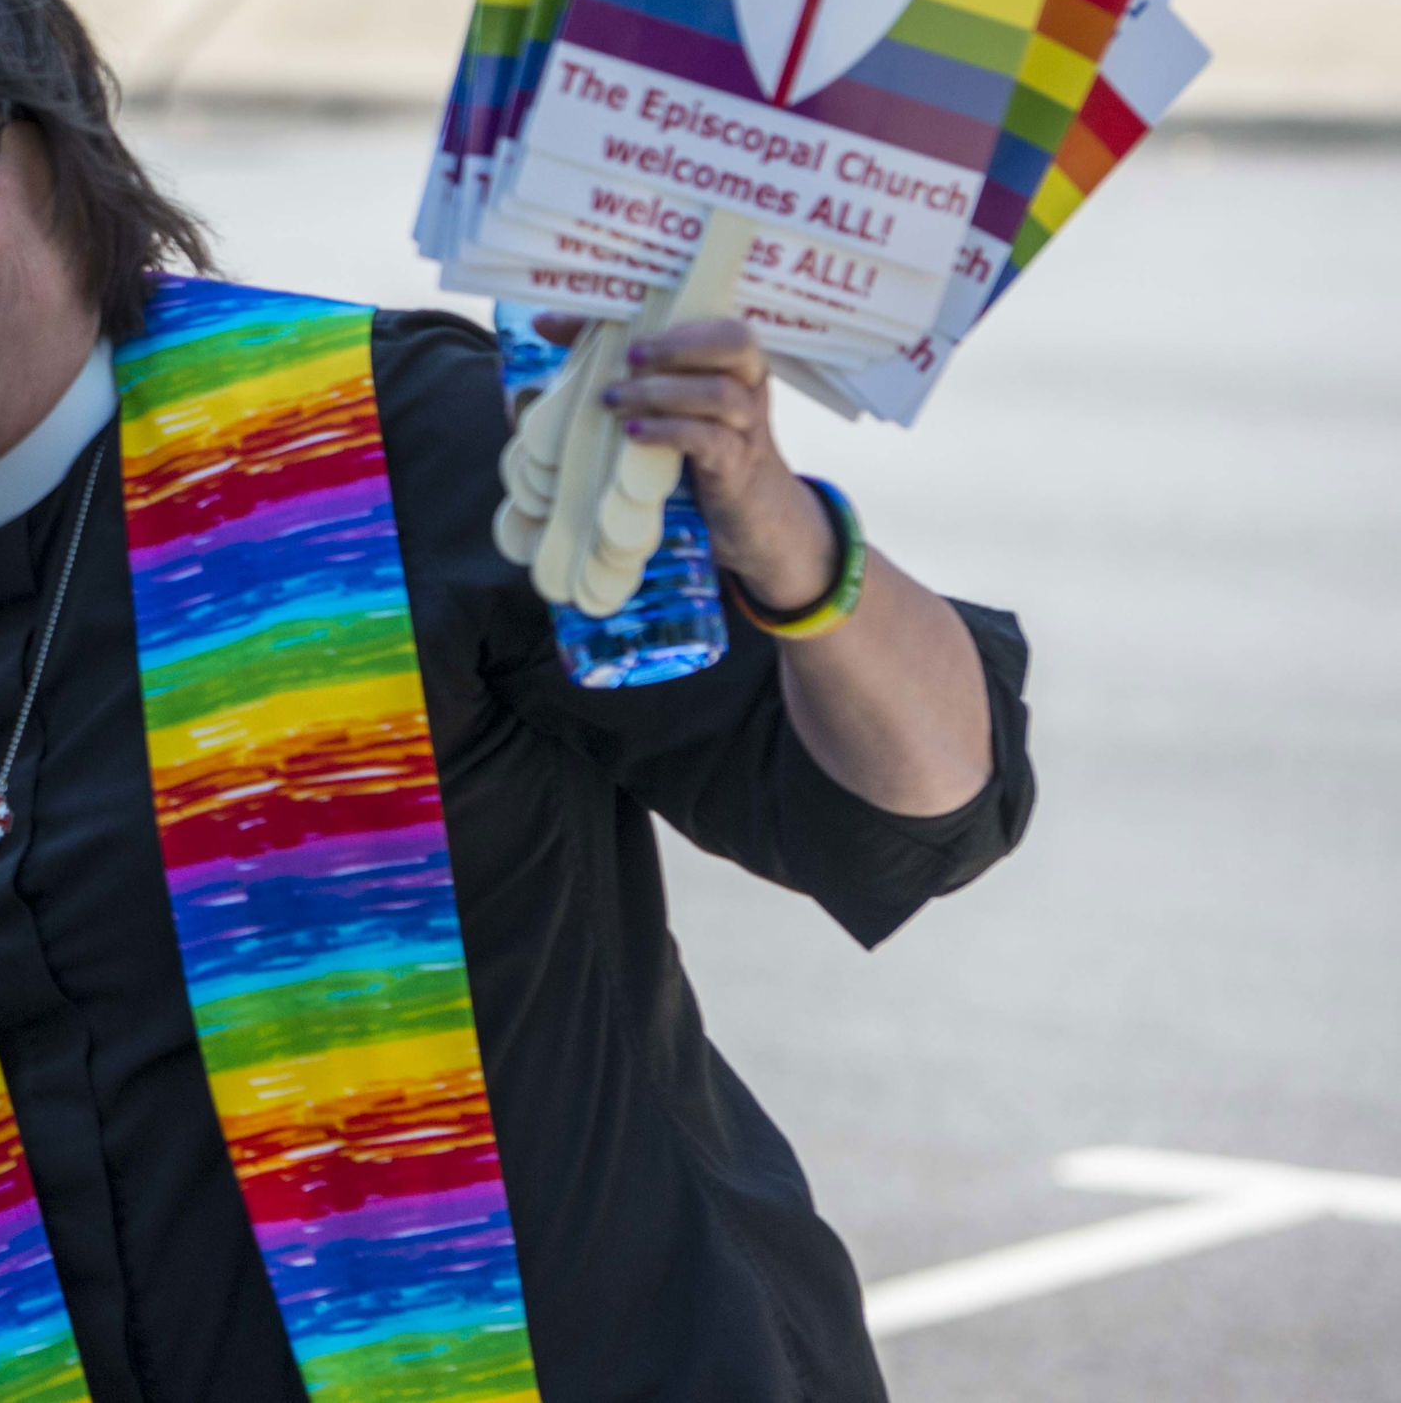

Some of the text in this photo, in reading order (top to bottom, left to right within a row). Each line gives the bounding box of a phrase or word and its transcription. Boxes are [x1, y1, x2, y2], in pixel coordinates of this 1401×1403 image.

[558, 61, 969, 218] The Episcopal Church
[603, 134, 895, 245] welcomes ALL!
[792, 247, 878, 299] ALL!
